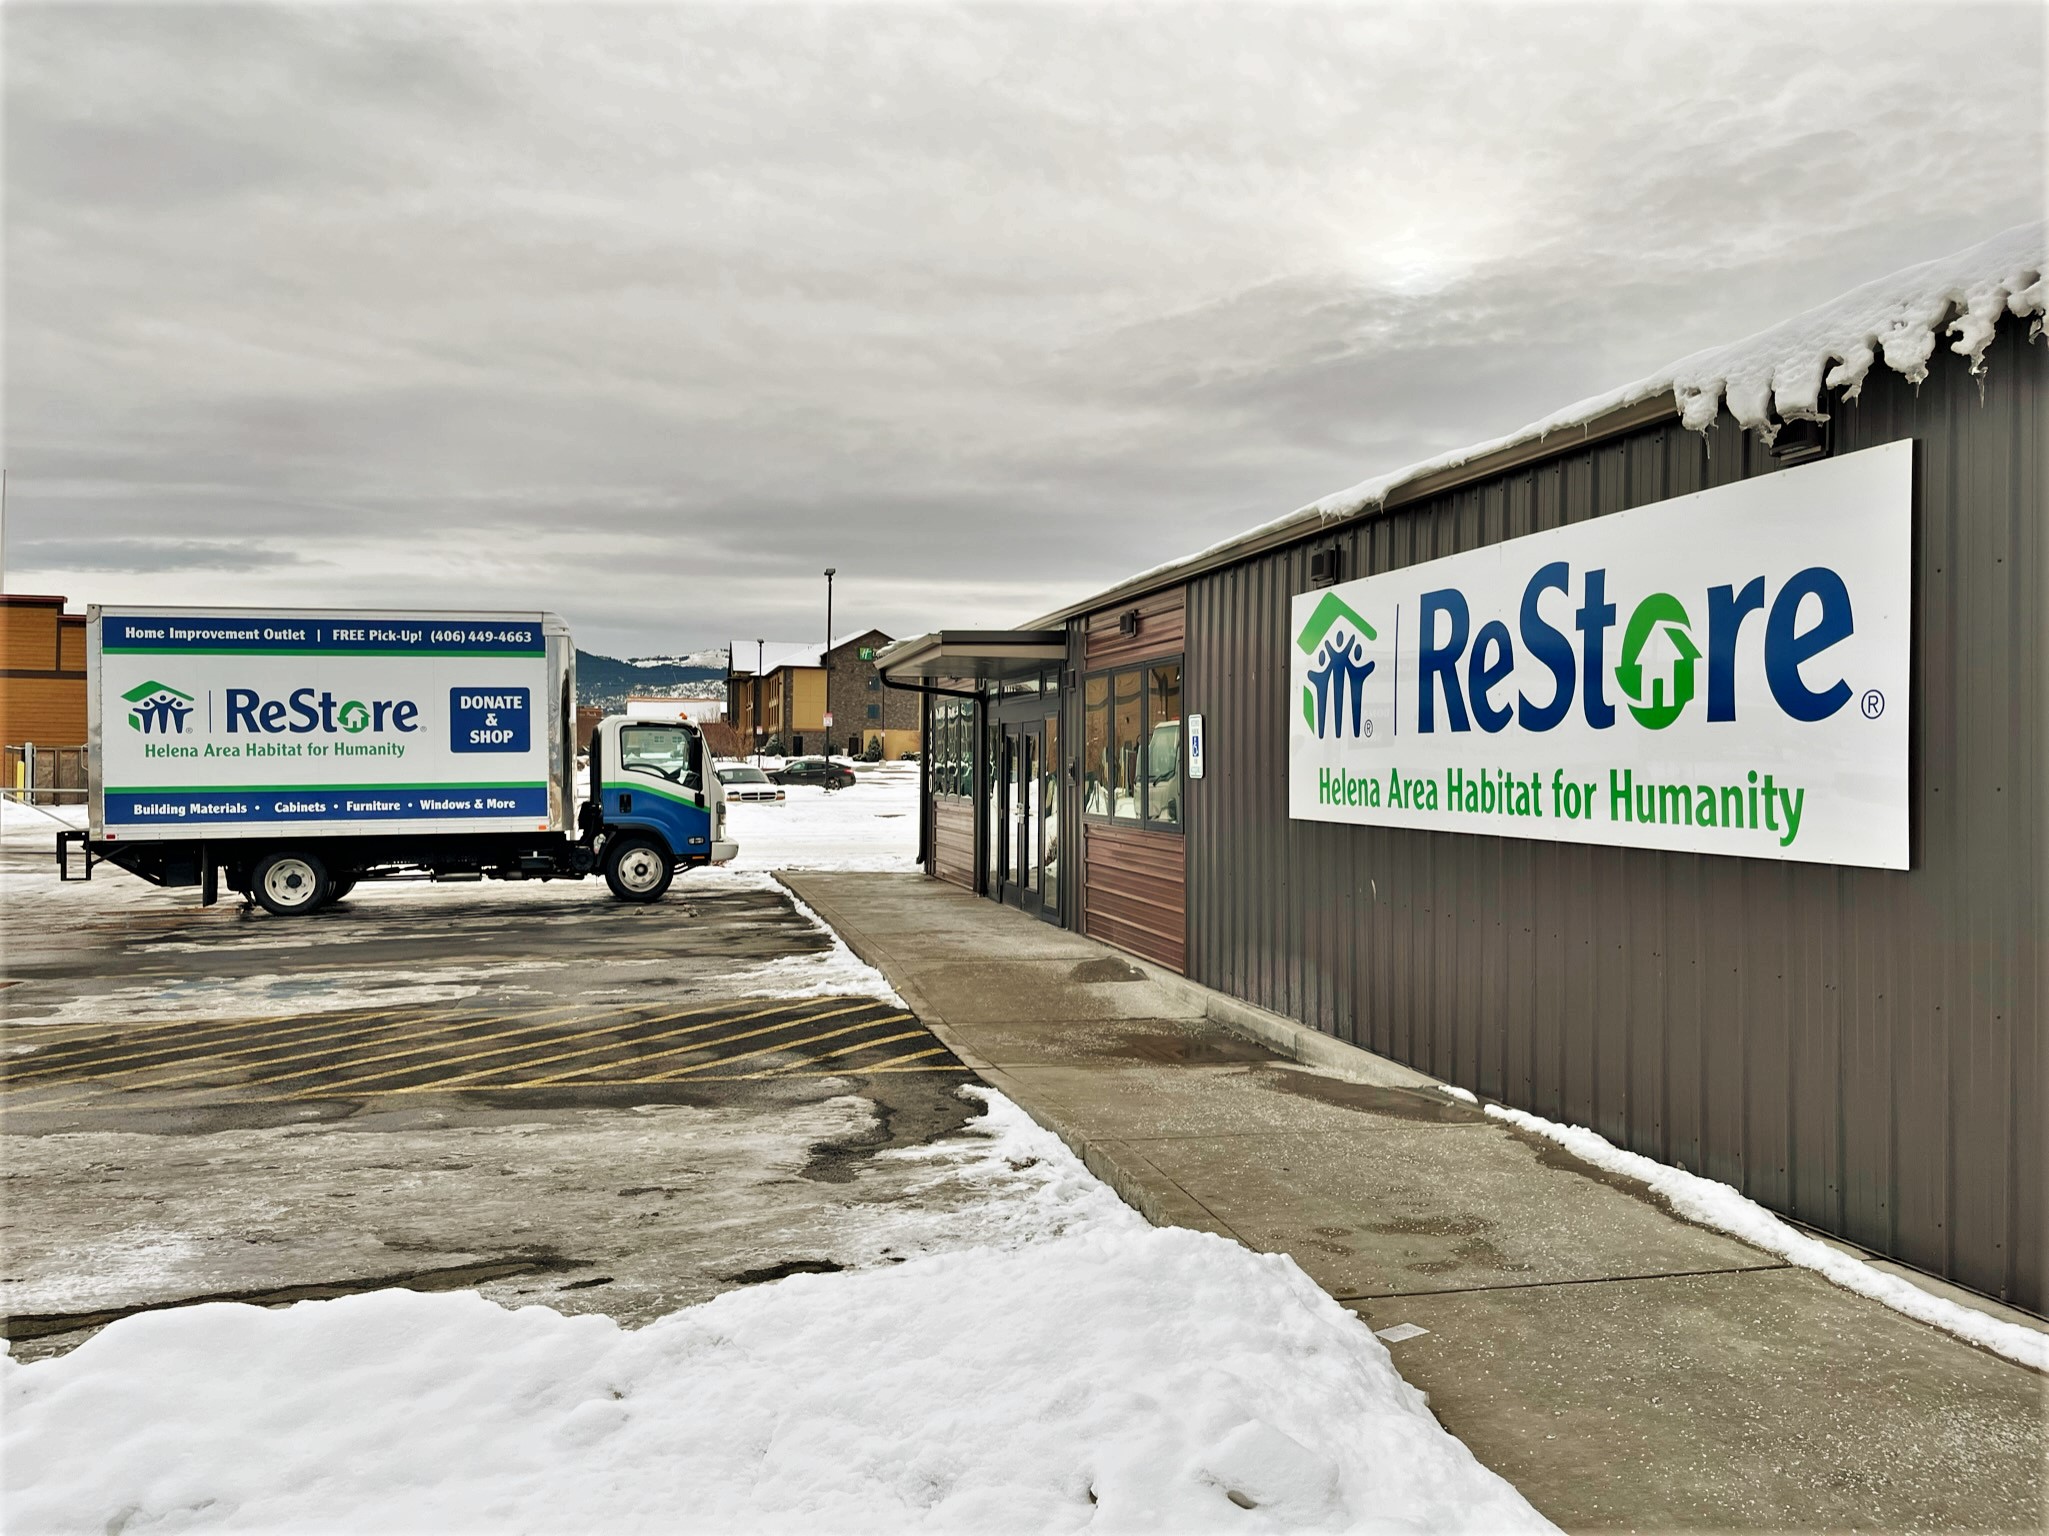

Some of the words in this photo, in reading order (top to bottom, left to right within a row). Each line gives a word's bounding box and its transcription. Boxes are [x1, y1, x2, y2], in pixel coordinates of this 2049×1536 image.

[125, 627, 165, 639] Home
[169, 627, 260, 641] Improvement
[263, 628, 306, 640] Outlet
[332, 629, 365, 641] FREE
[369, 629, 423, 643] Pick-Up!
[430, 630, 466, 643] (406)
[468, 631, 532, 643] 449-4663
[1418, 561, 1854, 733] ReStore
[460, 695, 523, 710] DONATE
[226, 688, 419, 734] ReStore
[485, 713, 498, 726] &
[469, 729, 514, 744] SHOP
[145, 744, 198, 758] Helena
[203, 743, 240, 757] Area
[246, 742, 302, 757] Habitat
[307, 742, 329, 756] for
[334, 742, 405, 758] Humanity
[133, 803, 186, 817] Building
[190, 803, 248, 815] Materials
[274, 802, 327, 813] Cabinets
[346, 800, 400, 812] Furniture
[420, 799, 471, 811] Windows
[474, 799, 484, 809] &
[486, 798, 516, 809] More
[1319, 767, 1381, 807] Helena
[1388, 768, 1438, 811] Area
[1447, 766, 1542, 817] Habitat
[1552, 769, 1597, 820] for
[1610, 769, 1805, 847] Humanity
